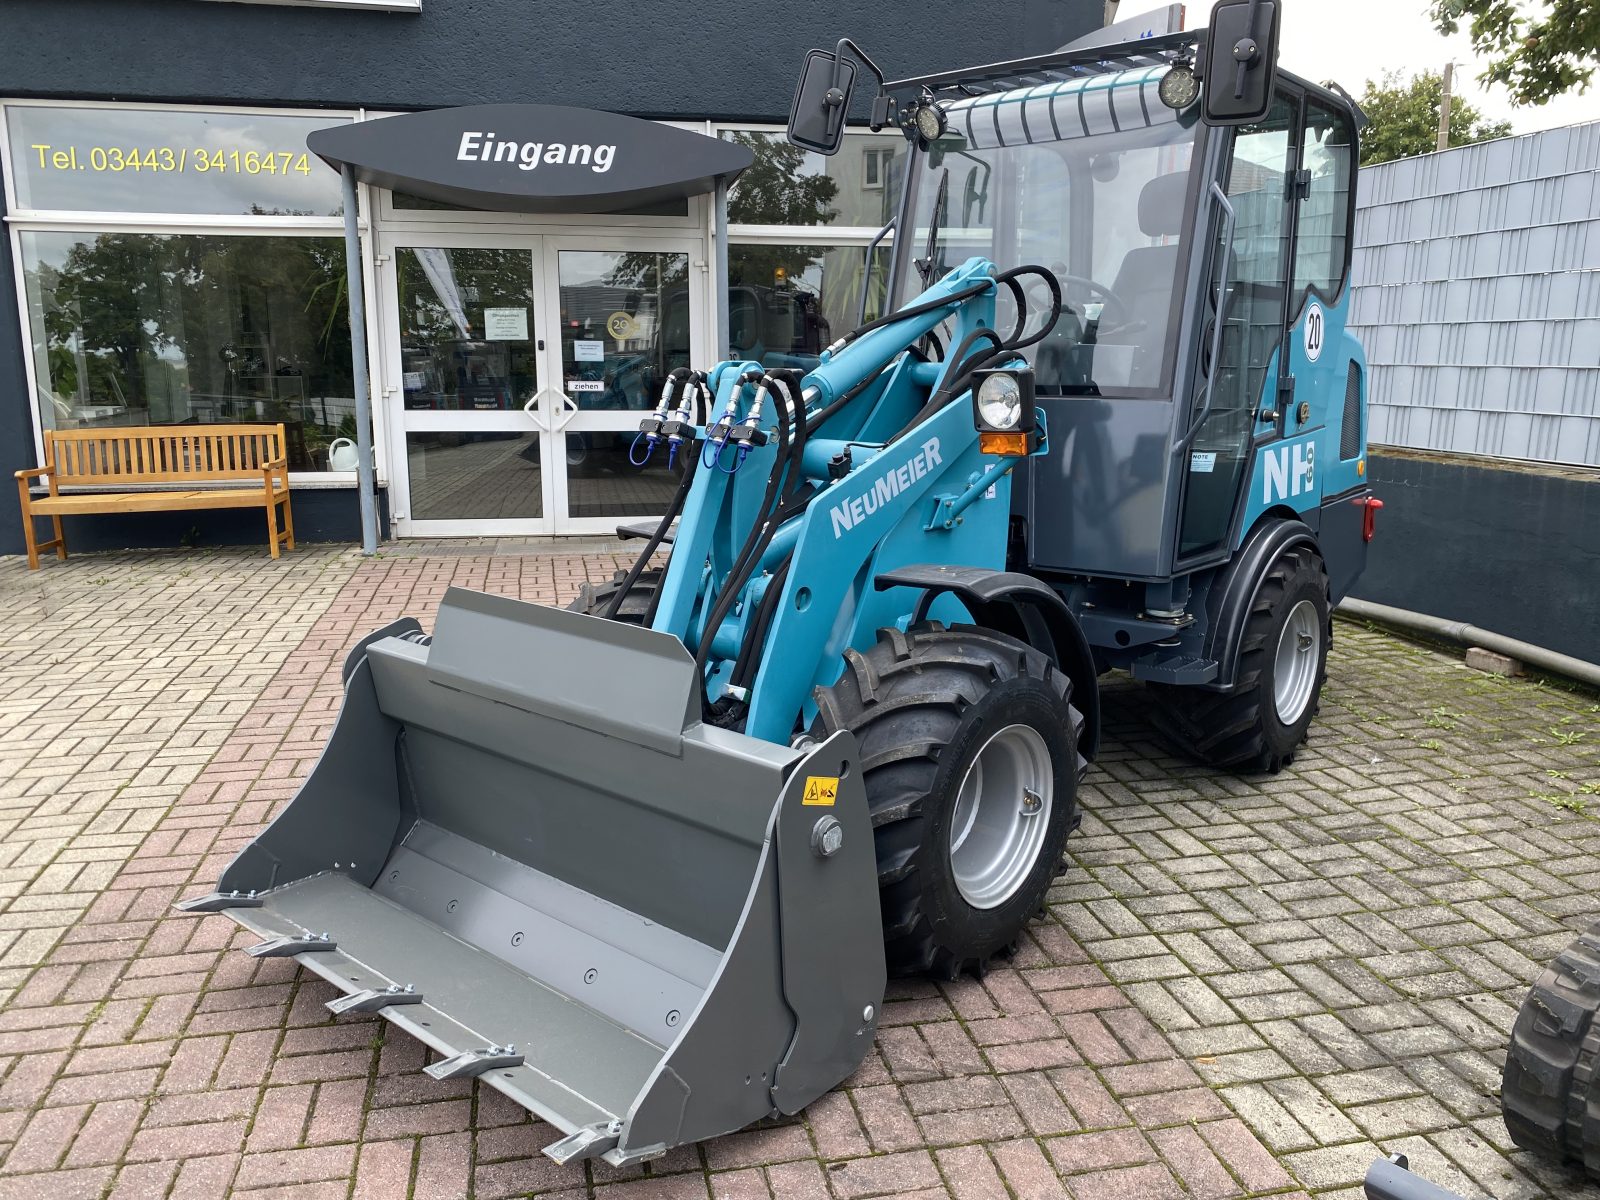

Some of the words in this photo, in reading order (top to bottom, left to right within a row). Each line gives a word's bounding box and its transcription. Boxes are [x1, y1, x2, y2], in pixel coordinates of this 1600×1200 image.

[31, 144, 85, 170] Tel.
[193, 148, 311, 176] 3416474
[456, 131, 617, 173] Eingang
[1308, 313, 1321, 350] 20
[1263, 440, 1315, 505] NH
